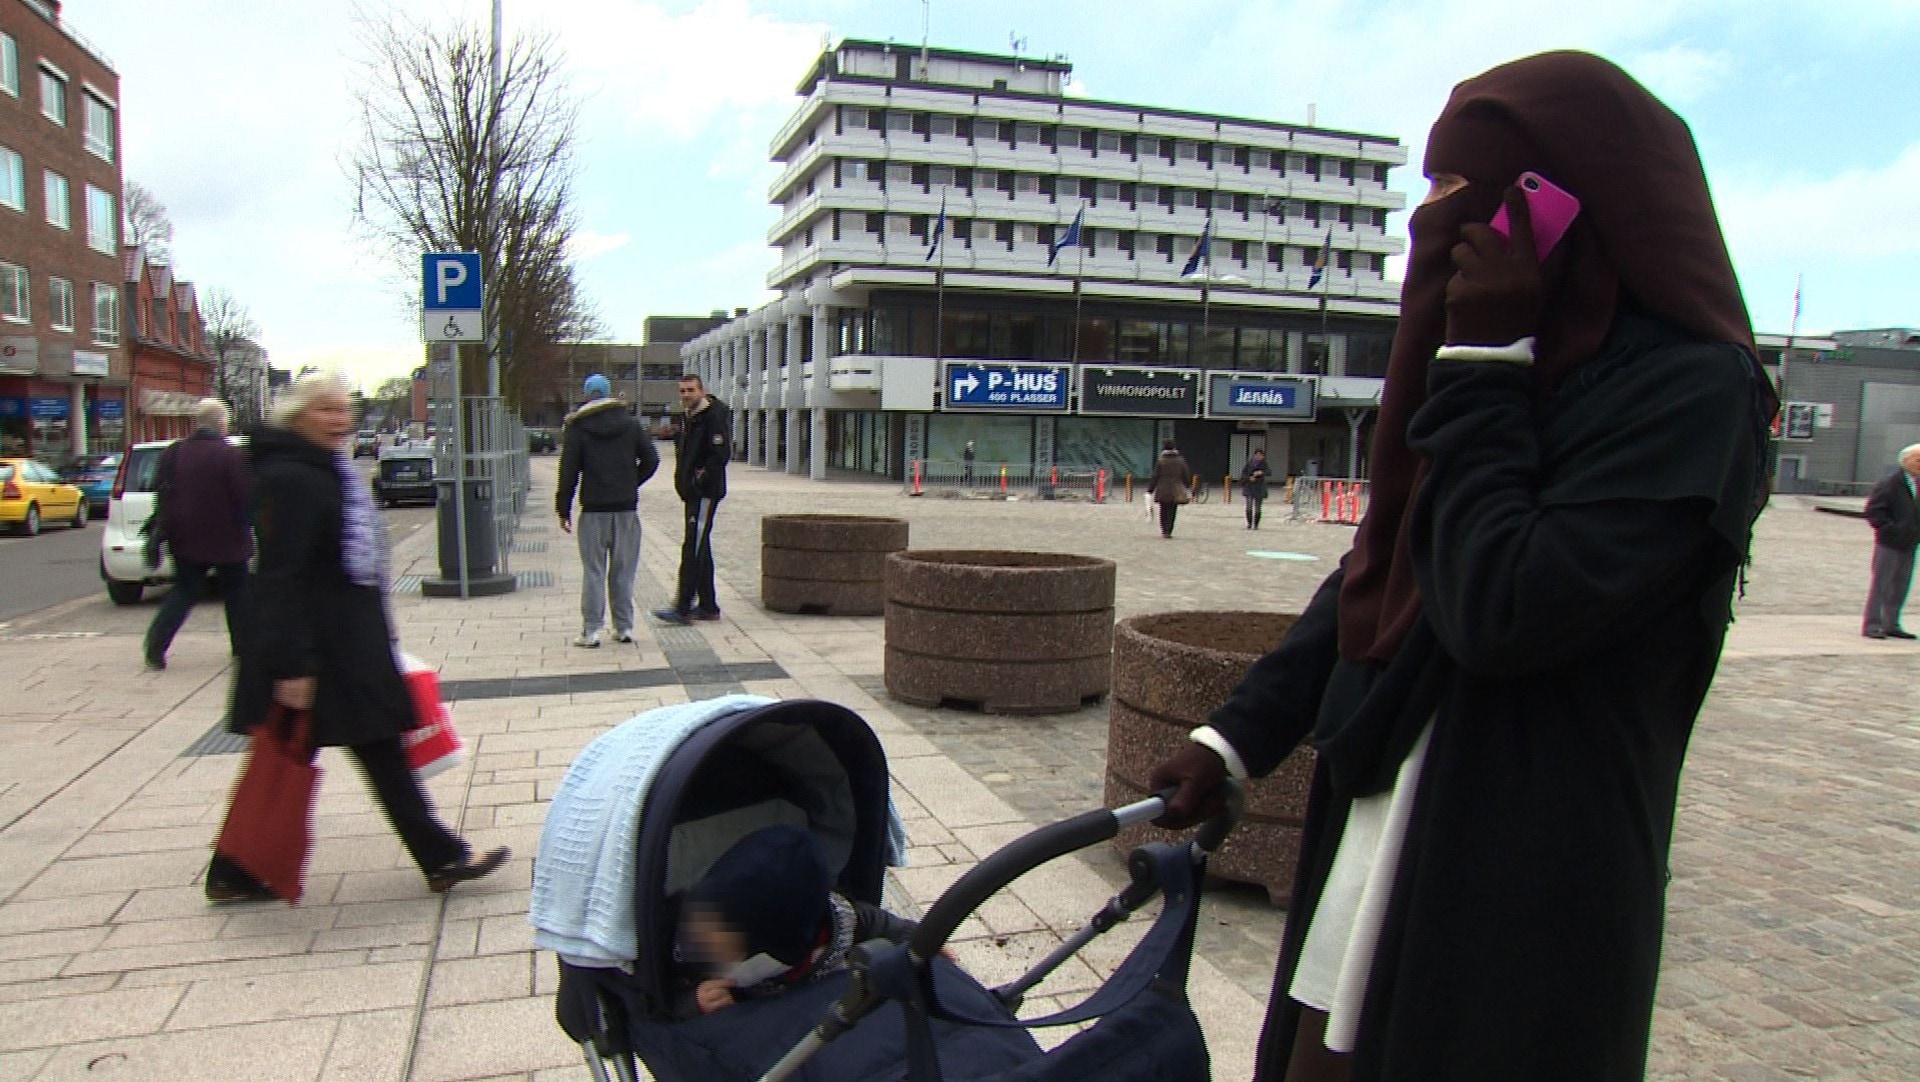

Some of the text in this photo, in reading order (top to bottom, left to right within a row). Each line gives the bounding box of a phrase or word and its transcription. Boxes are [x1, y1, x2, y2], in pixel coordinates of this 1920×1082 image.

[437, 260, 467, 304] P
[988, 371, 1059, 392] P-HUS
[988, 391, 1057, 403] 400 PLASSER
[1096, 384, 1186, 399] VINMONOPOLET
